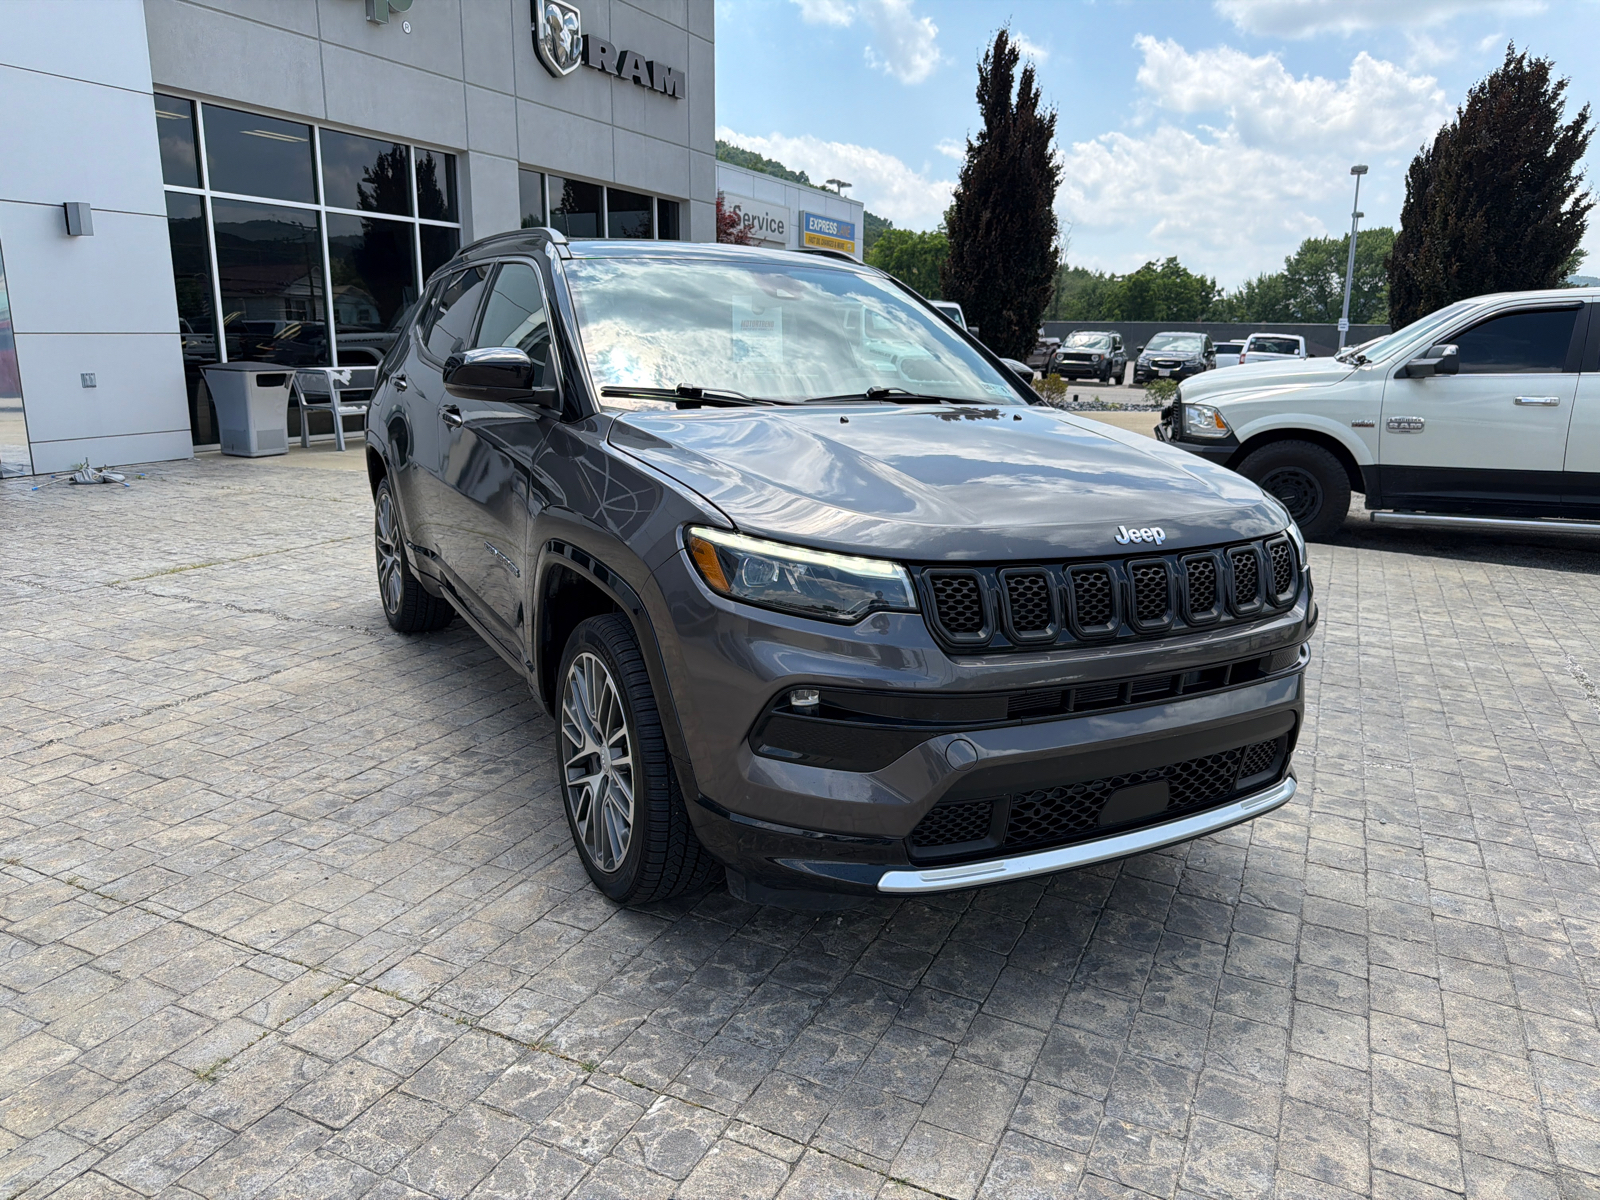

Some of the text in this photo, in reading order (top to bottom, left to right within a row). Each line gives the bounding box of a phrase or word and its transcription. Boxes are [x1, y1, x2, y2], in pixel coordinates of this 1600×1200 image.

[583, 34, 686, 99] RAM
[733, 204, 785, 235] Service
[809, 217, 837, 234] EXPRESS
[1114, 525, 1166, 546] Jeep
